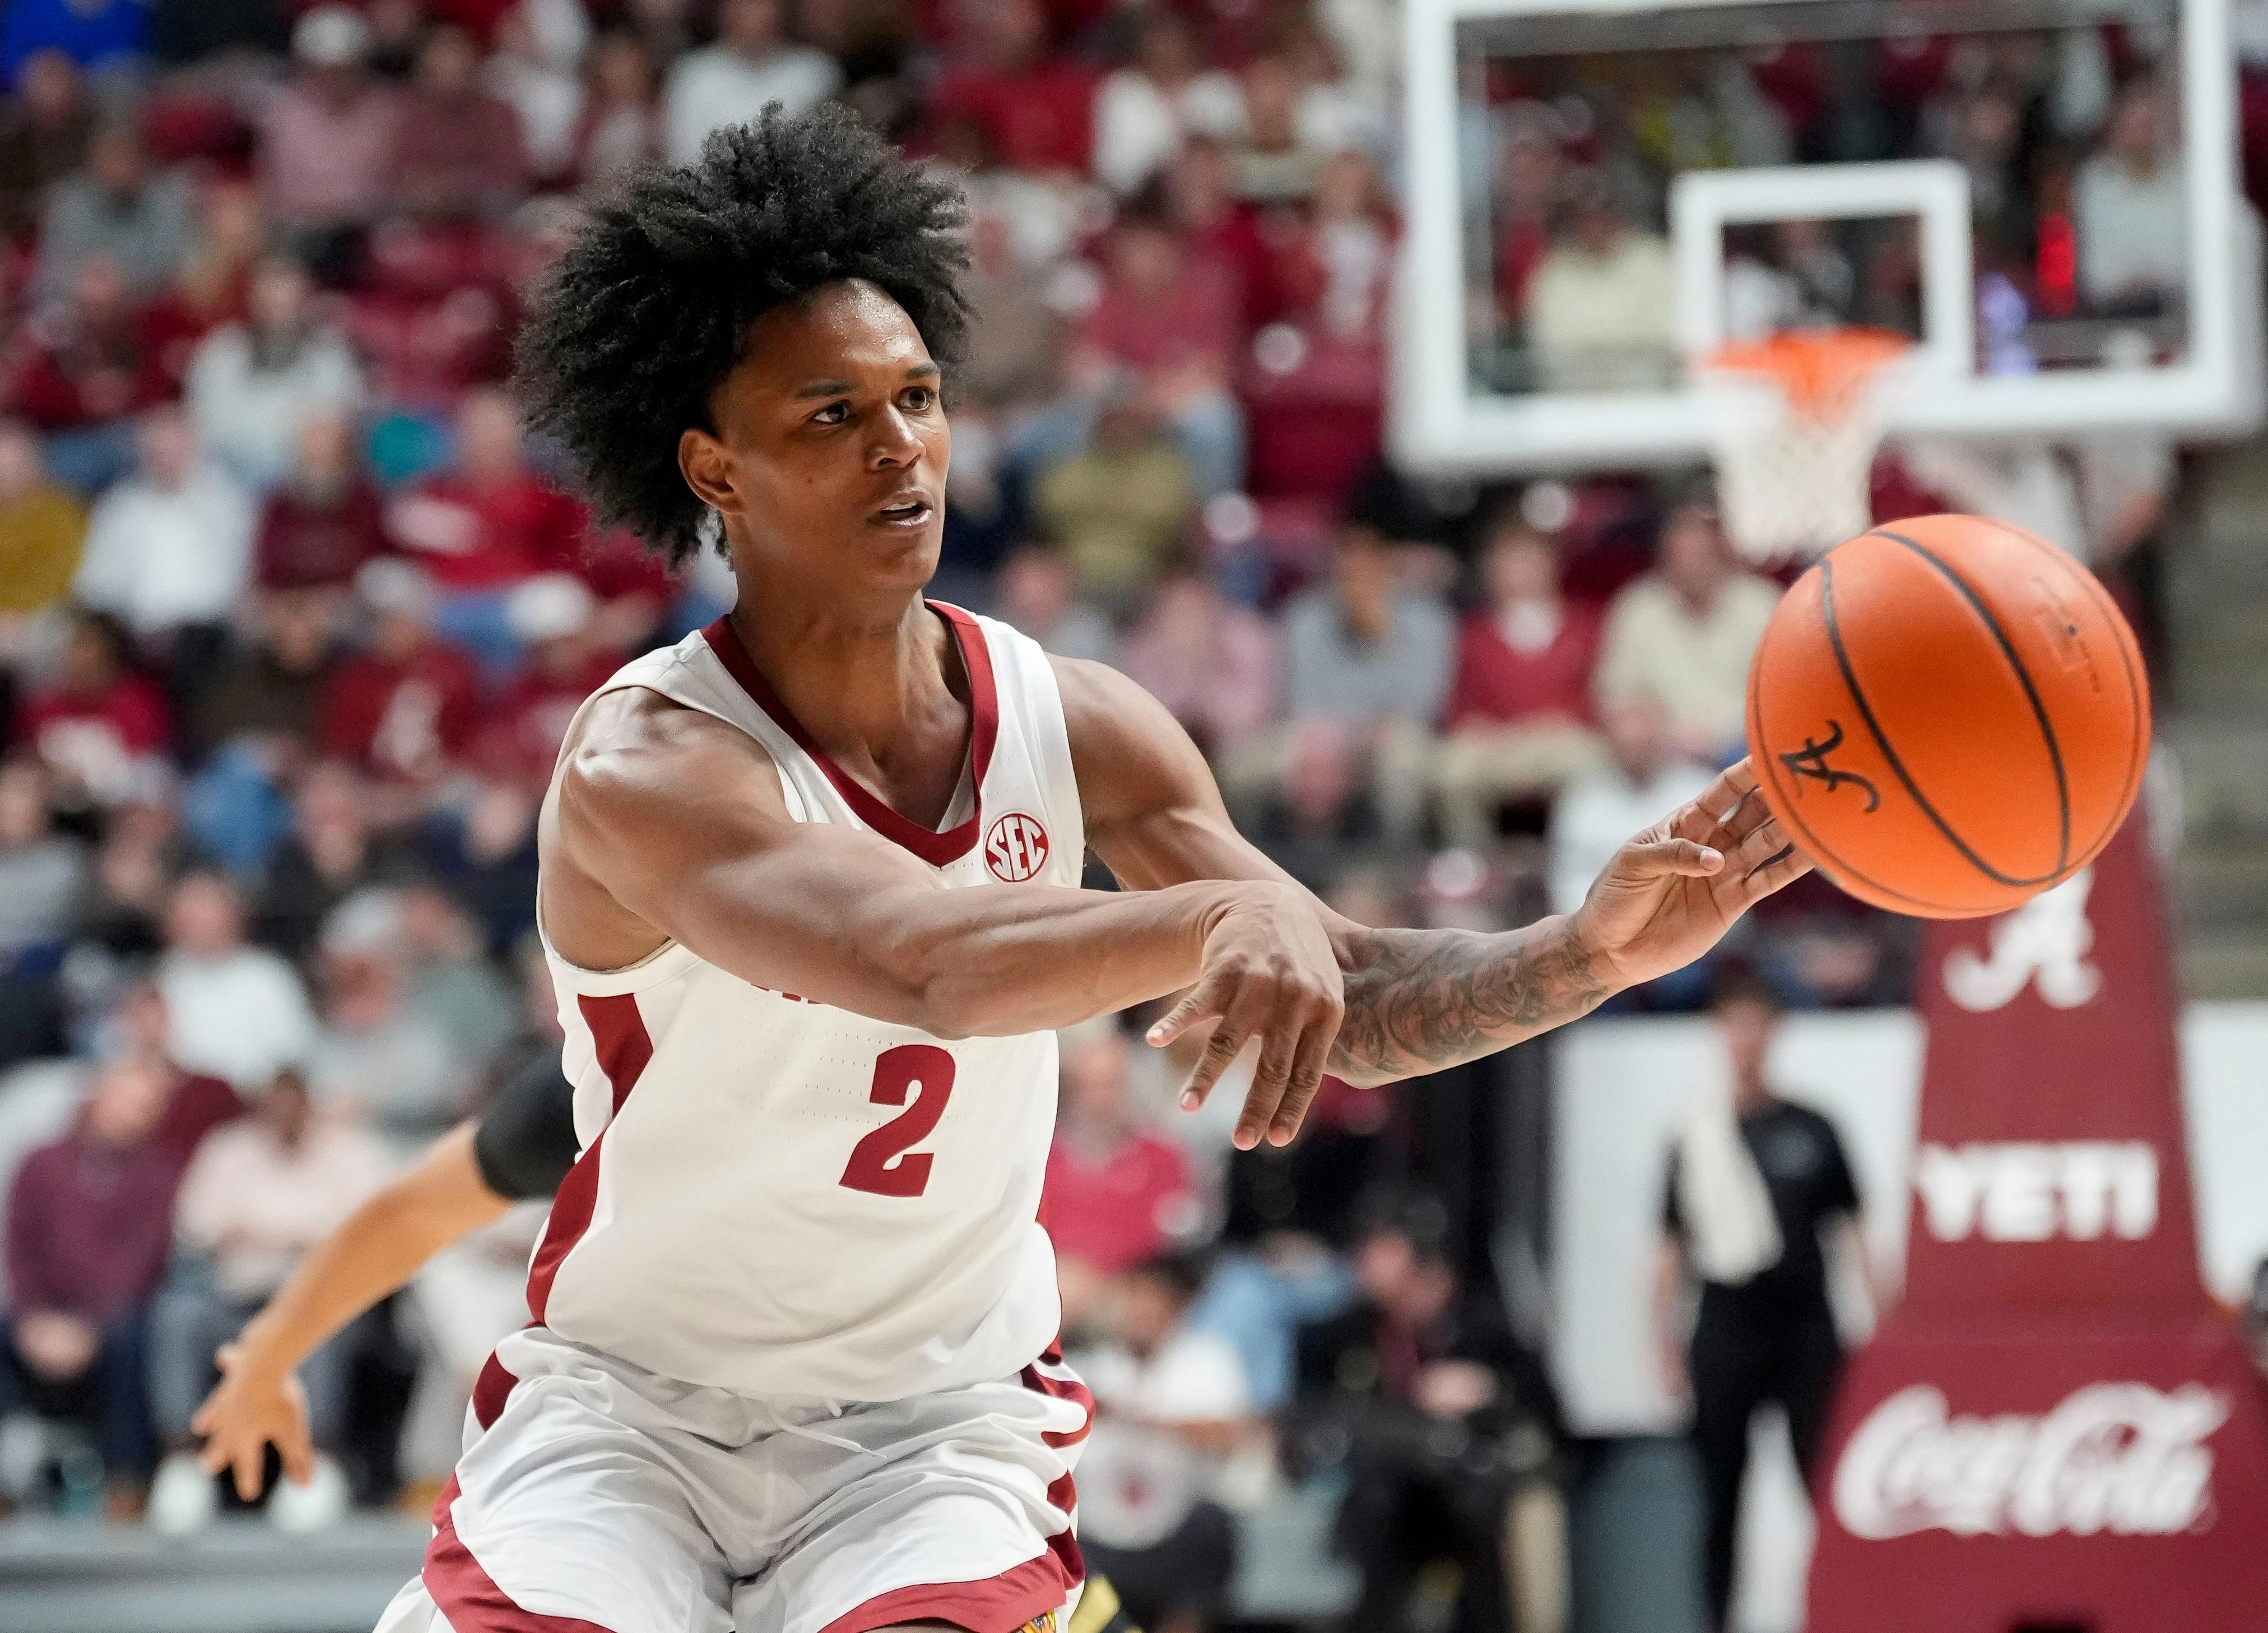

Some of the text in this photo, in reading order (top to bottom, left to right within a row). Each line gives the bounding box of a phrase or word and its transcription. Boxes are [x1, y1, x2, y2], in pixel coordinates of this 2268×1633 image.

[1779, 719, 1880, 814] A
[987, 814, 1048, 880] SEC
[838, 1044, 956, 1197] 2
[1915, 1141, 2158, 1241] YETI
